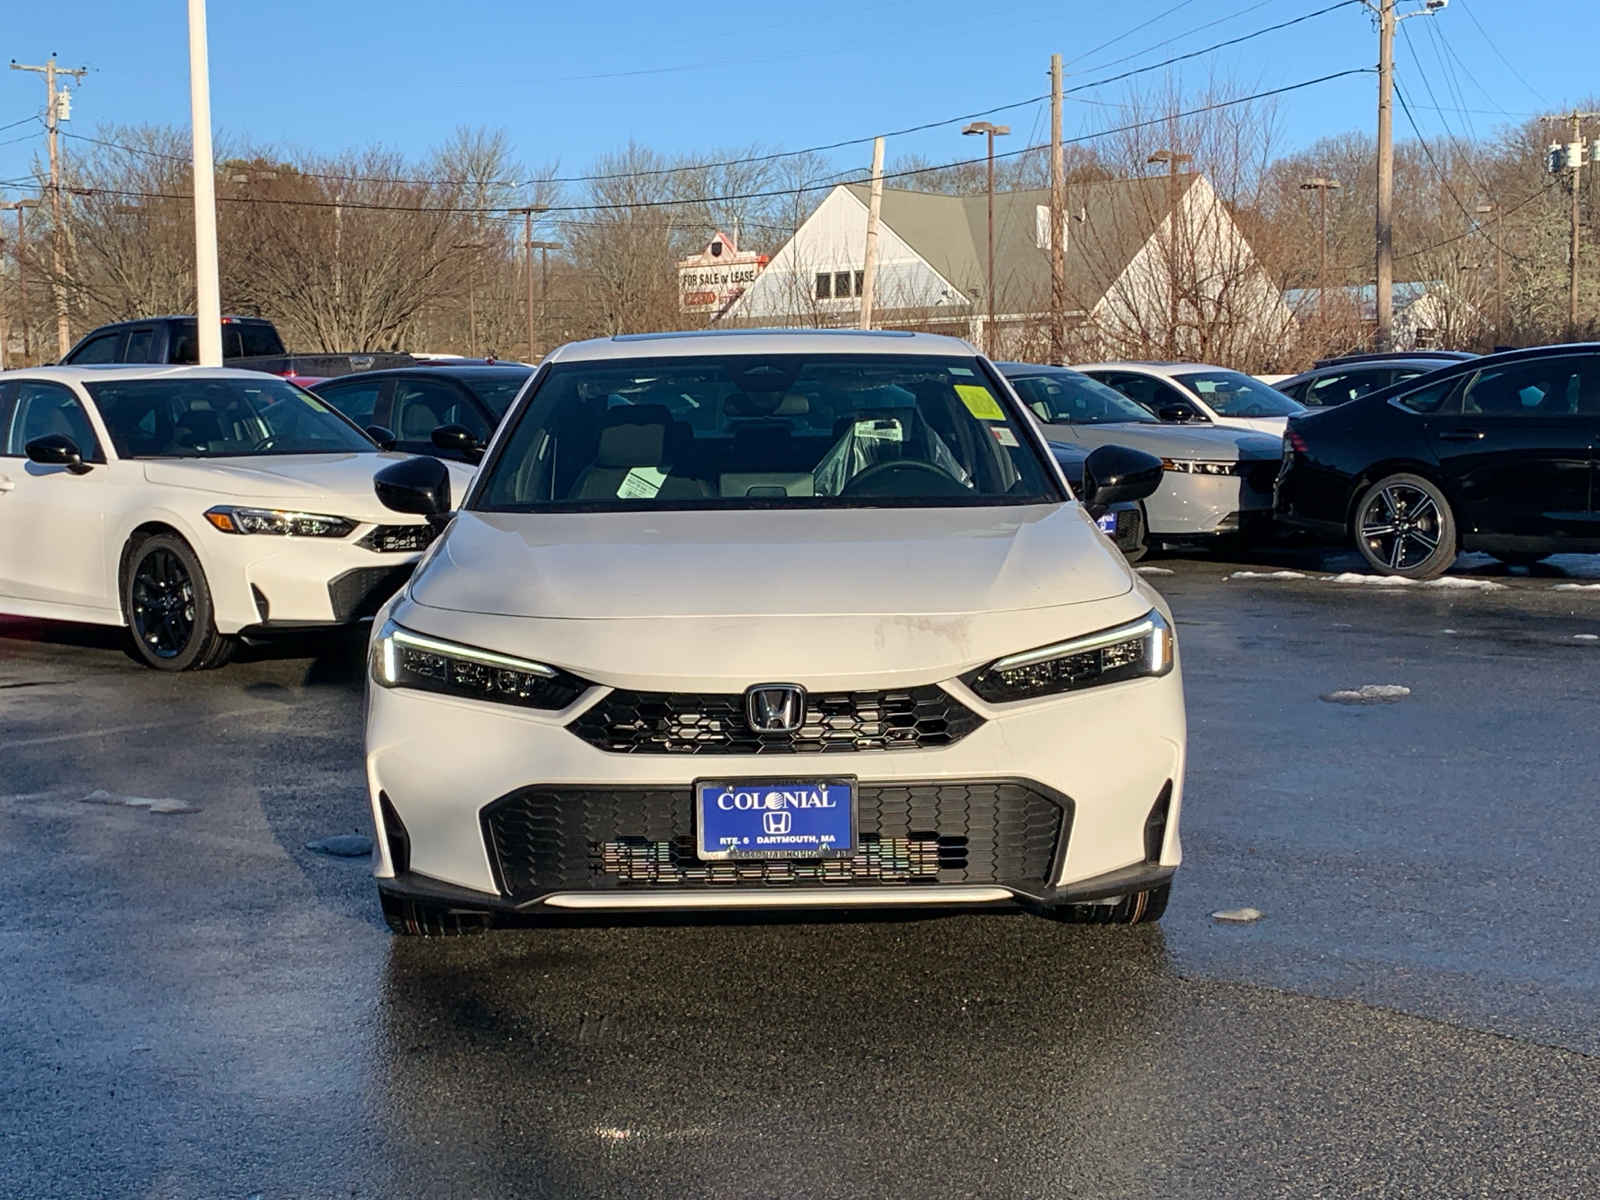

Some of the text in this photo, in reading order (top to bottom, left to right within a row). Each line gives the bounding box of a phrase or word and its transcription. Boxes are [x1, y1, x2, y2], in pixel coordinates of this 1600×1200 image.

[683, 270, 755, 286] FOR SALE or LEASE
[717, 791, 837, 811] COLONIAL
[719, 837, 741, 845] RTE.
[756, 835, 819, 844] DARTMOUTH,
[820, 835, 836, 843] MA
